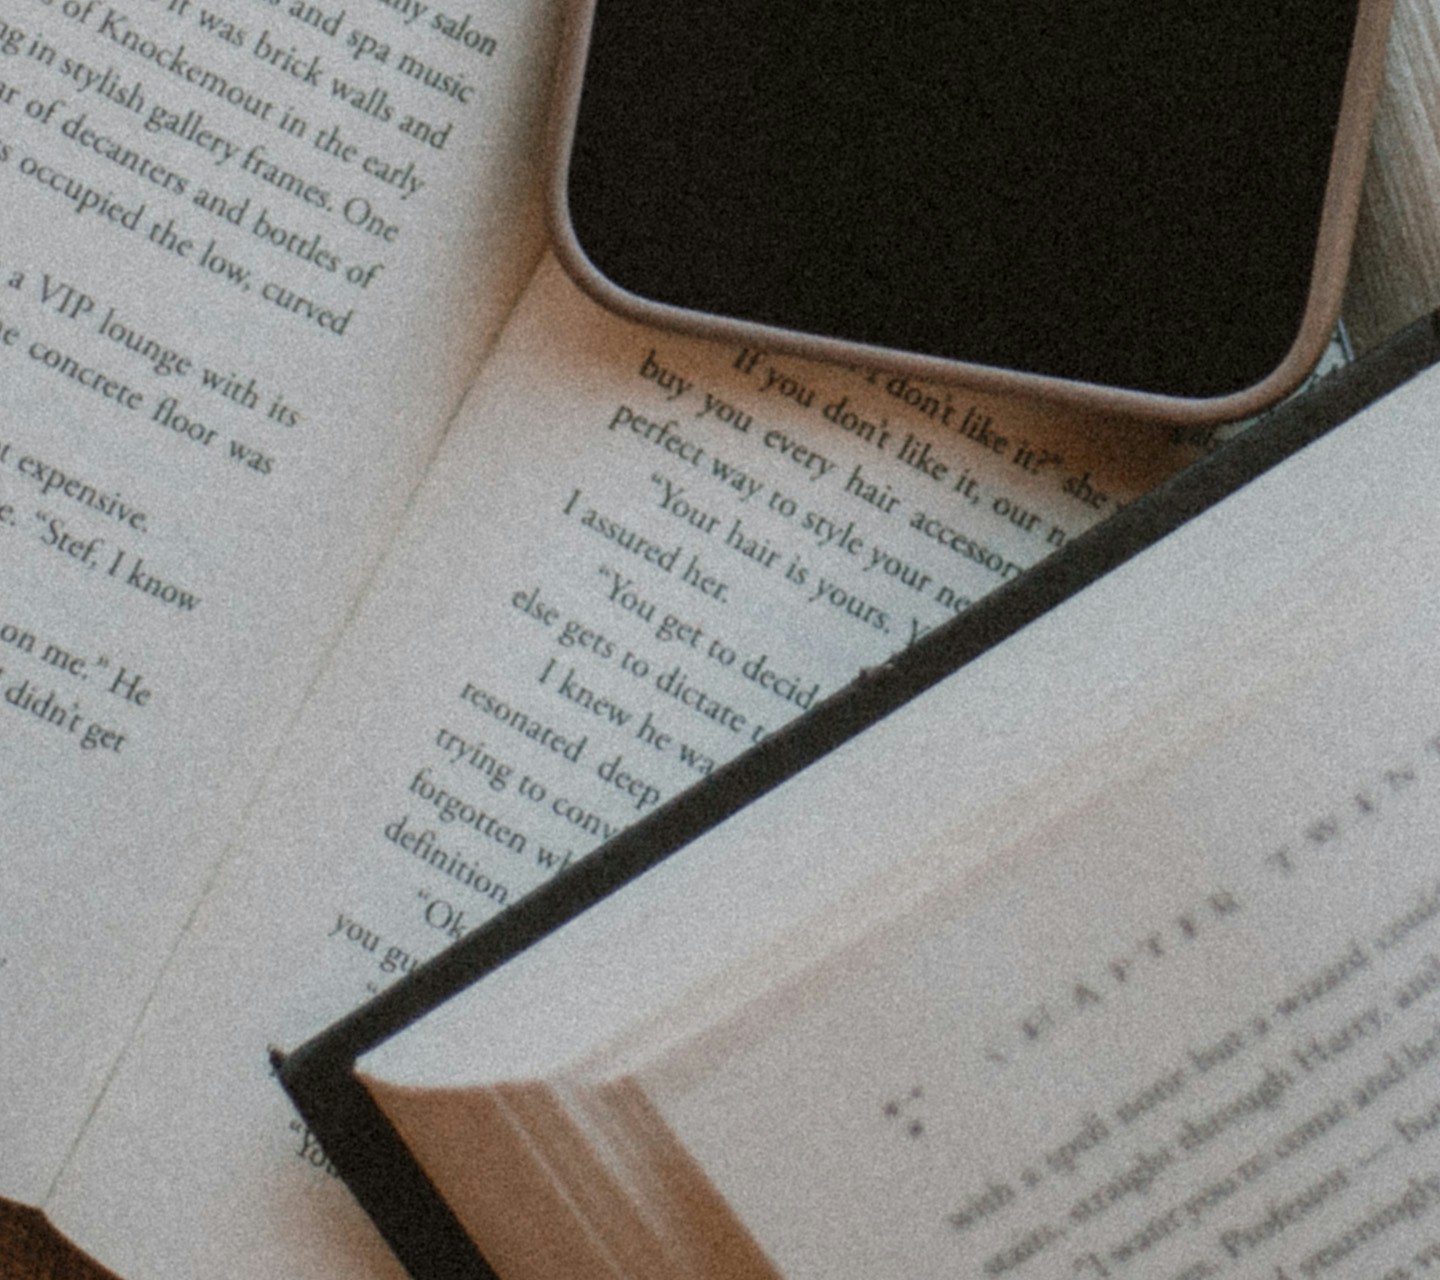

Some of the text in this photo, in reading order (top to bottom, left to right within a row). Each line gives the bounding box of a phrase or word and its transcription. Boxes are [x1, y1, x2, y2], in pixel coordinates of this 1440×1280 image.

[756, 366, 818, 410] you
[819, 395, 893, 451] don’t
[894, 431, 951, 483] like
[951, 466, 981, 507] it,
[988, 495, 1044, 534] our
[559, 485, 730, 605] I assured her.
